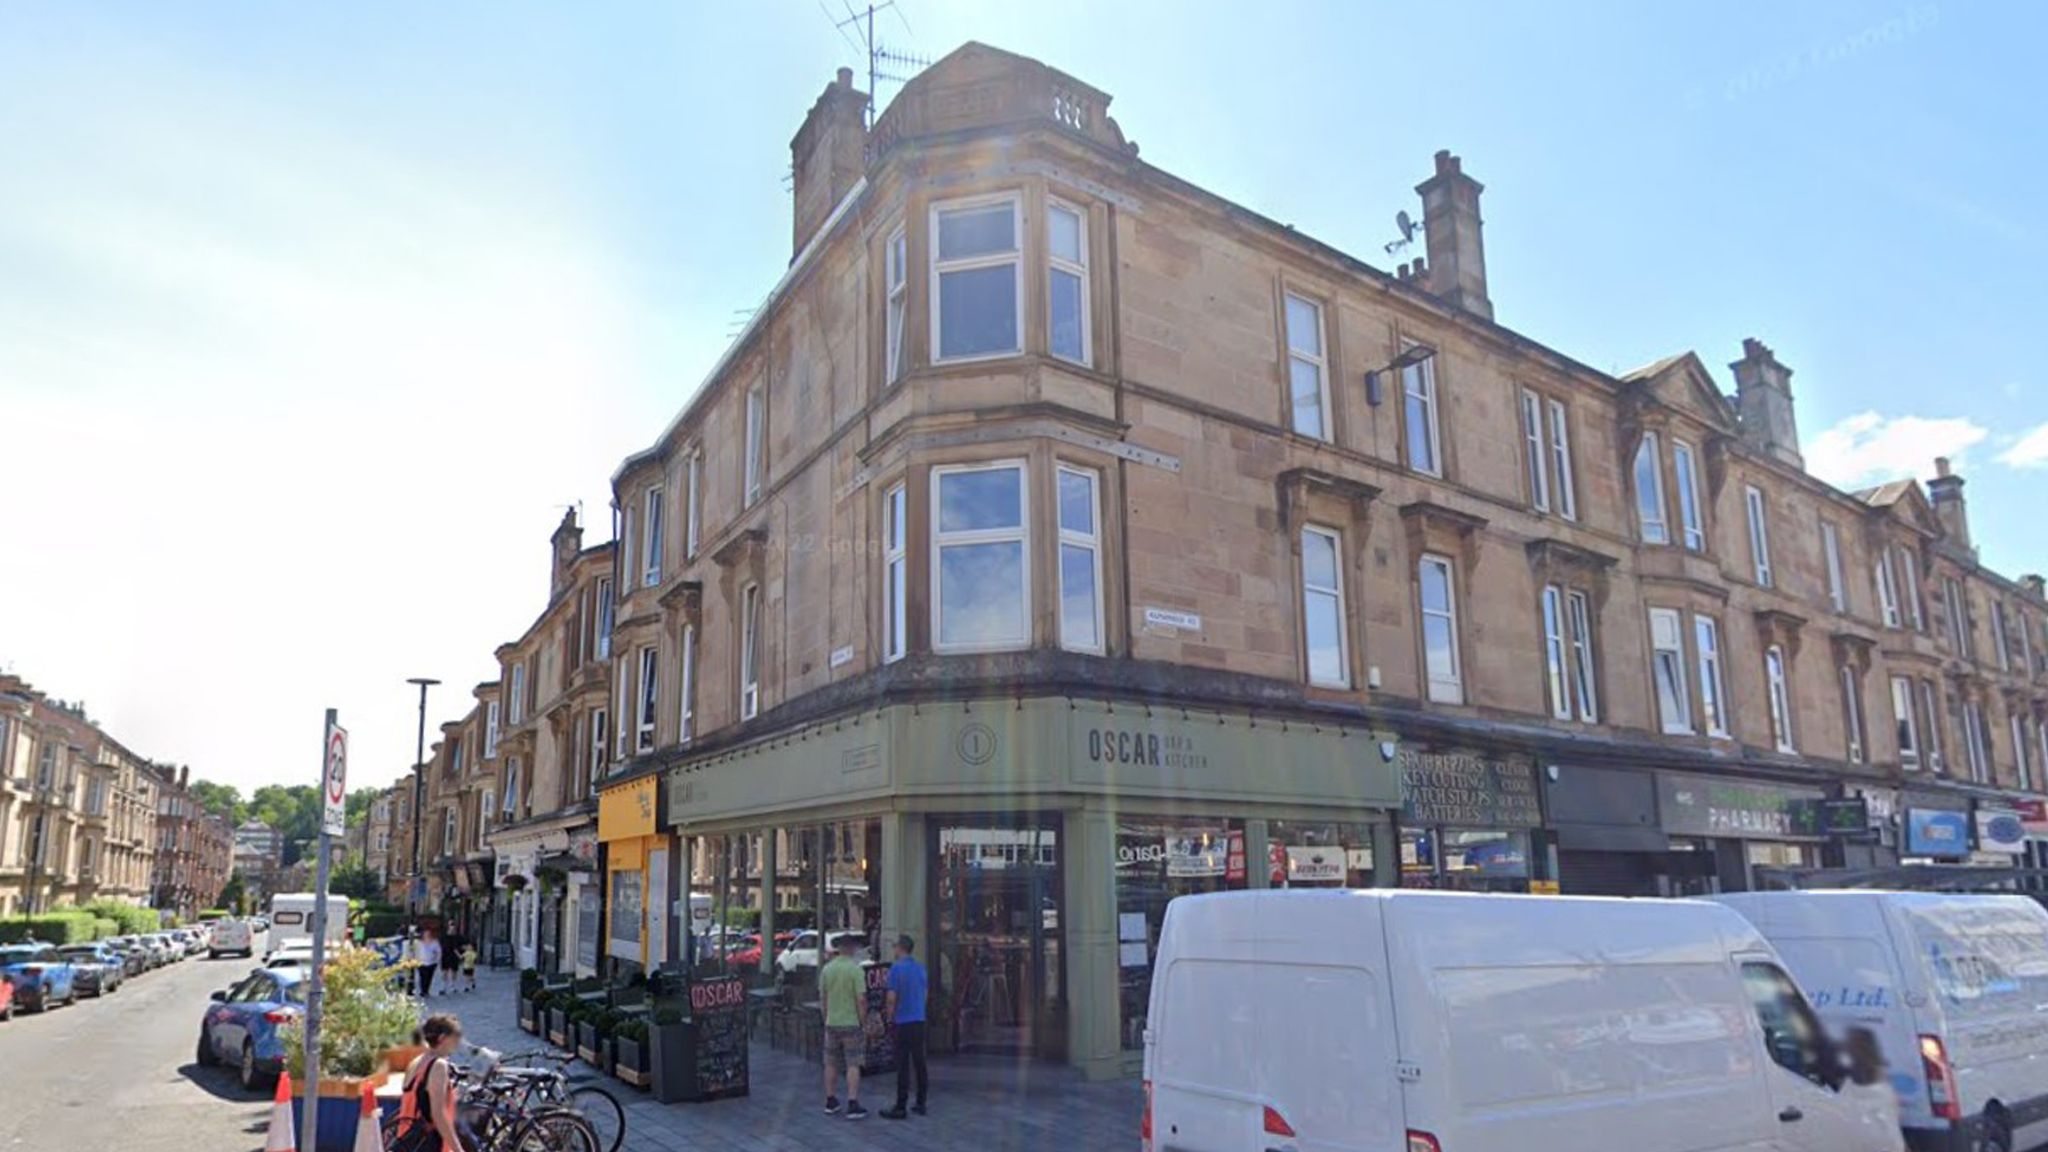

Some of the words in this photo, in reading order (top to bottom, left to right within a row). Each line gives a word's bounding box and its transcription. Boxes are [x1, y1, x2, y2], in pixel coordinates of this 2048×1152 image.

[1089, 729, 1159, 766] OSCAR
[1401, 770, 1429, 786] KEY
[1432, 771, 1484, 790] CUTTING
[1400, 786, 1446, 804] WATCH
[1447, 788, 1491, 807] STRAPS
[1415, 804, 1481, 822] BATTERIES
[1708, 807, 1792, 834] PHARMACY
[691, 981, 744, 1008] OSCAR
[1840, 987, 1888, 1008] Ltd.
